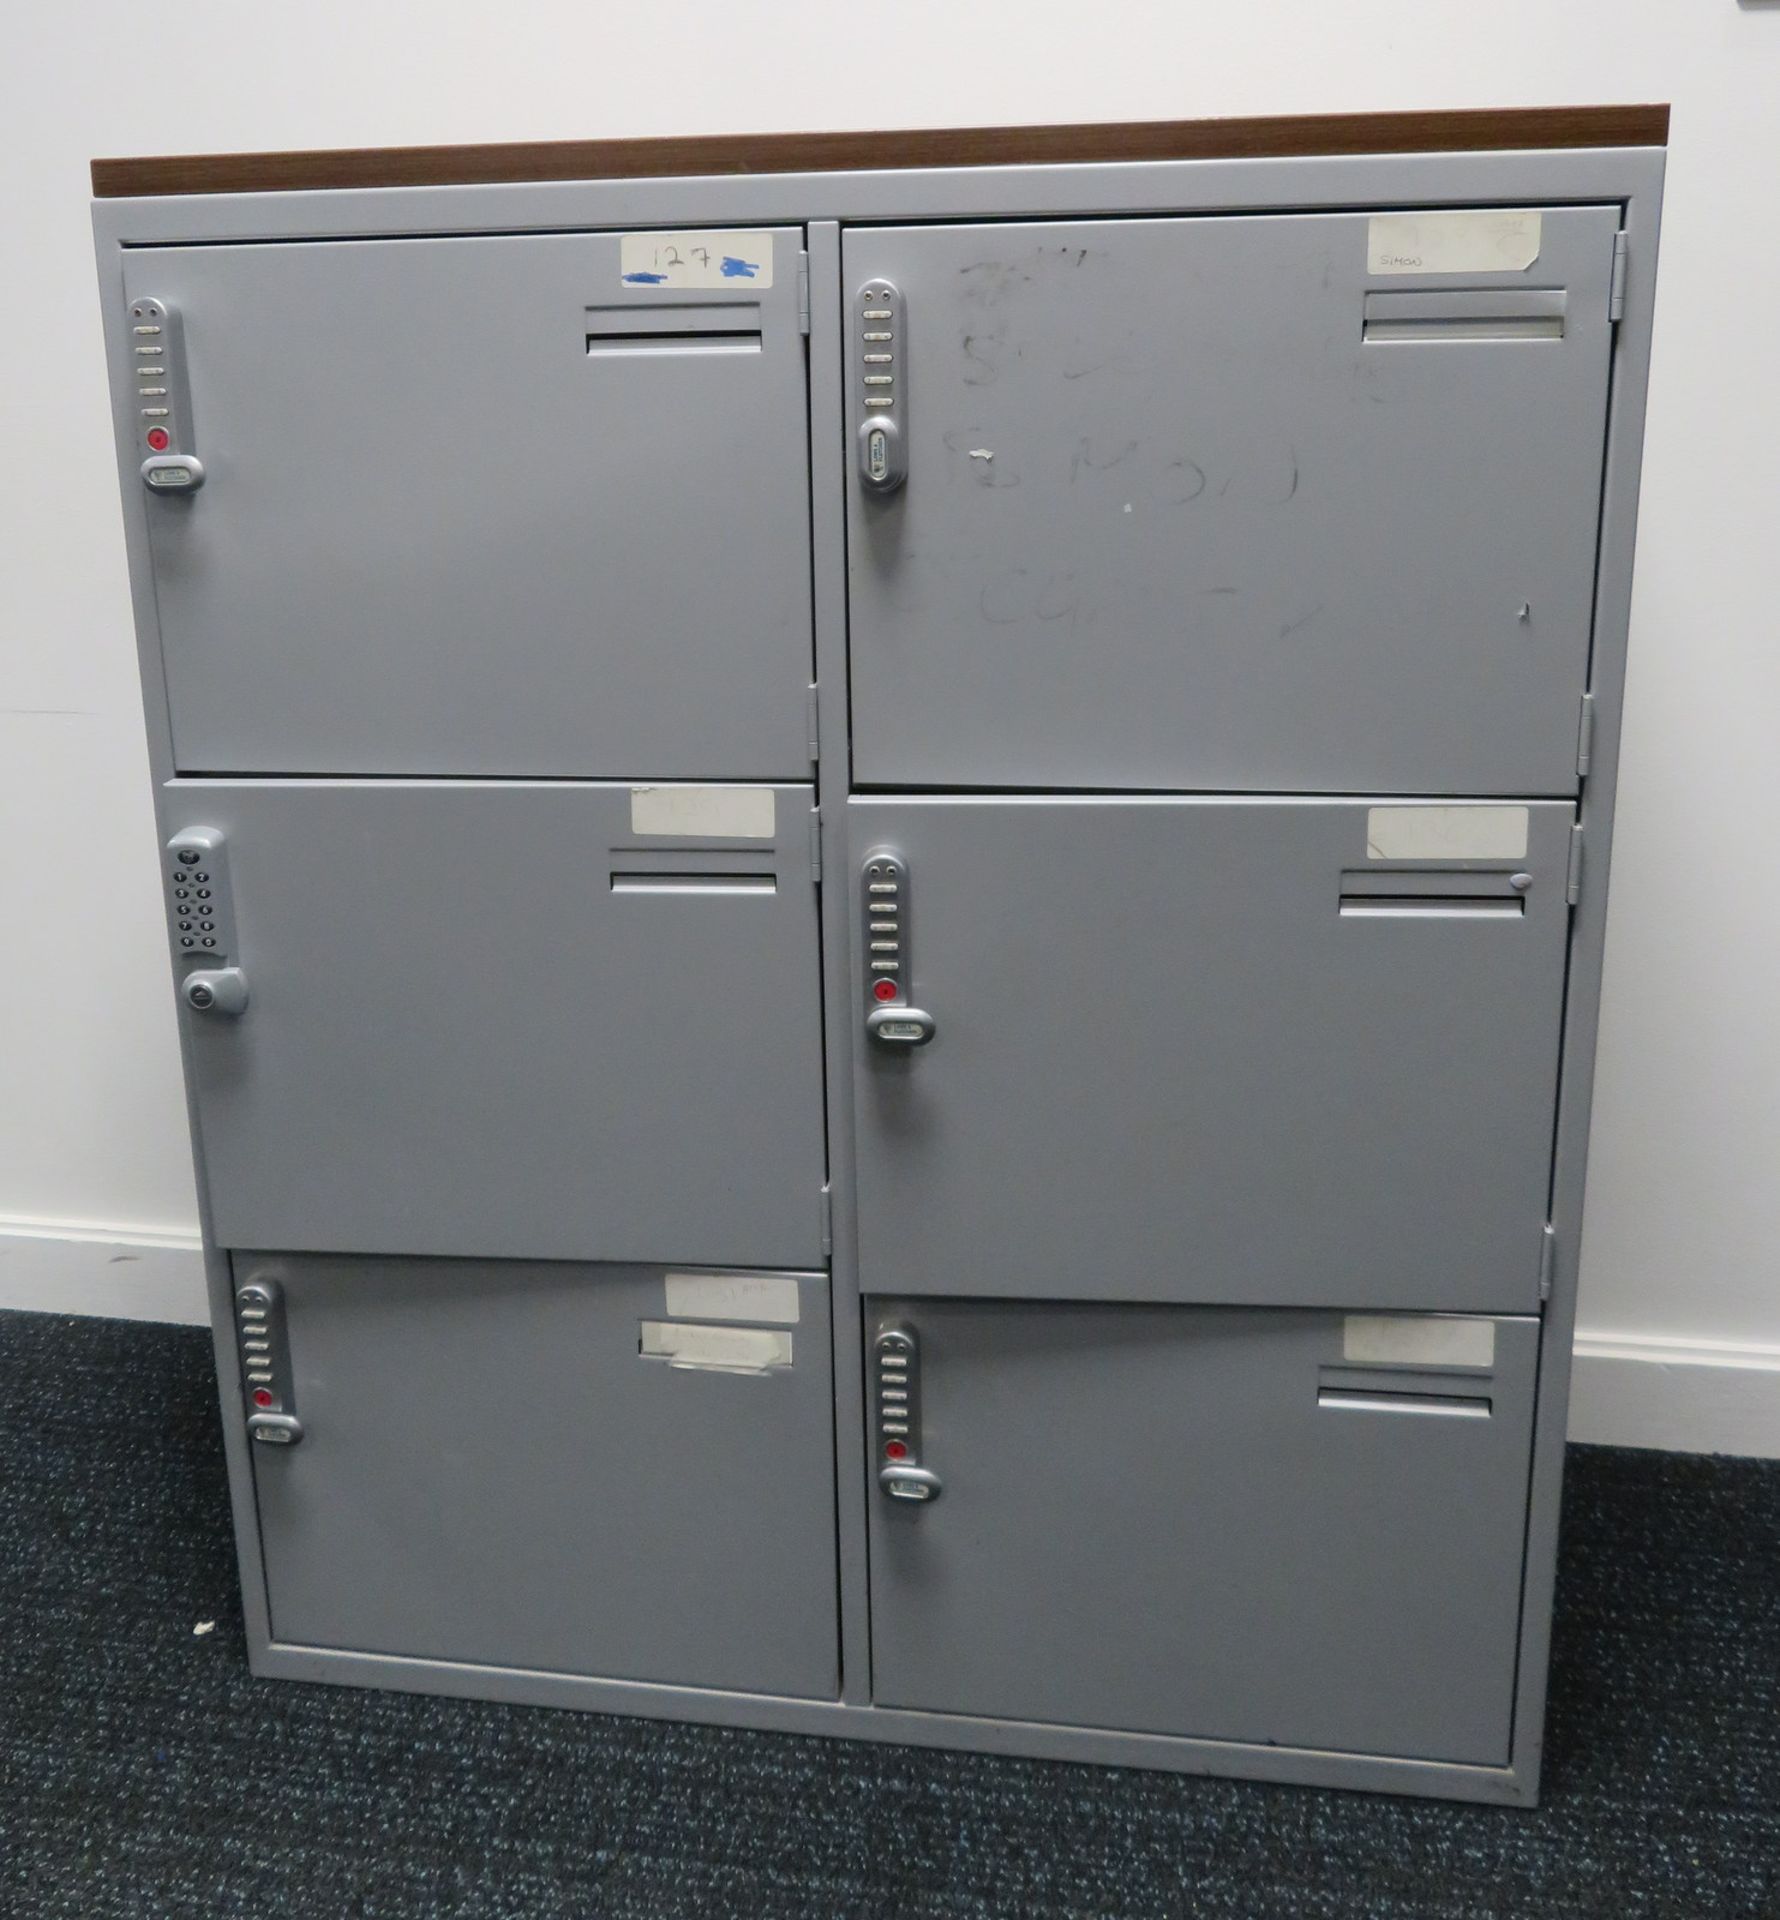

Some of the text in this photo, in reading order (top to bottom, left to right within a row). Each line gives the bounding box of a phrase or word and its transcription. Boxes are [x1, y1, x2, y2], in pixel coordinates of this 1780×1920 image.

[654, 246, 711, 269] 127
[198, 873, 205, 881] 2
[178, 889, 185, 897] 3
[180, 905, 186, 914] 5
[202, 906, 209, 914] 6
